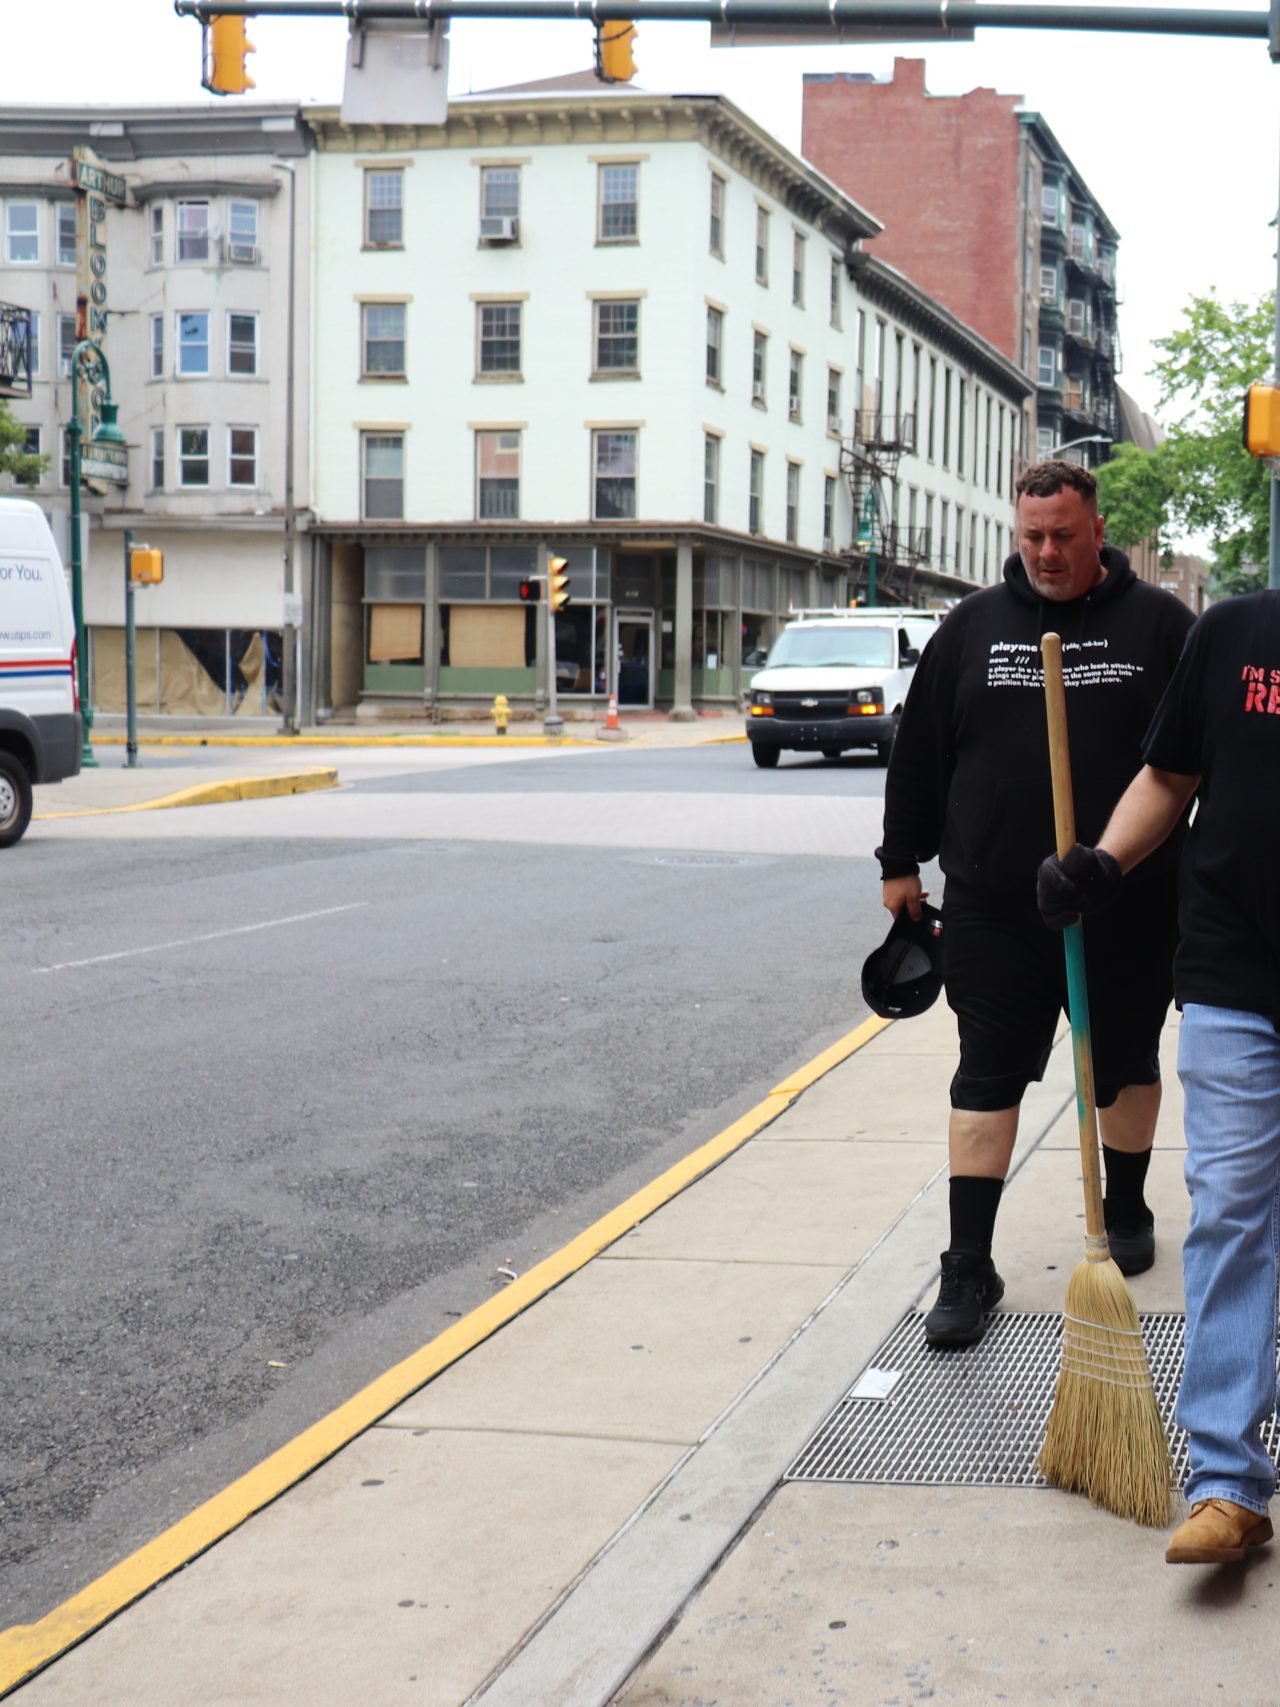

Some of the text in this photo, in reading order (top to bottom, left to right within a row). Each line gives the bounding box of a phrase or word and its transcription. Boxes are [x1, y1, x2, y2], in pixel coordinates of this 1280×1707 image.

[80, 164, 126, 200] ARTHUR
[90, 195, 107, 334] BLOOM
[15, 564, 43, 581] You.
[990, 641, 1038, 654] playma
[994, 665, 1017, 674] player
[1090, 662, 1109, 670] leads
[1110, 663, 1135, 671] attacks
[1241, 665, 1265, 682] I'M
[993, 679, 1021, 687] position
[1081, 677, 1100, 685] could
